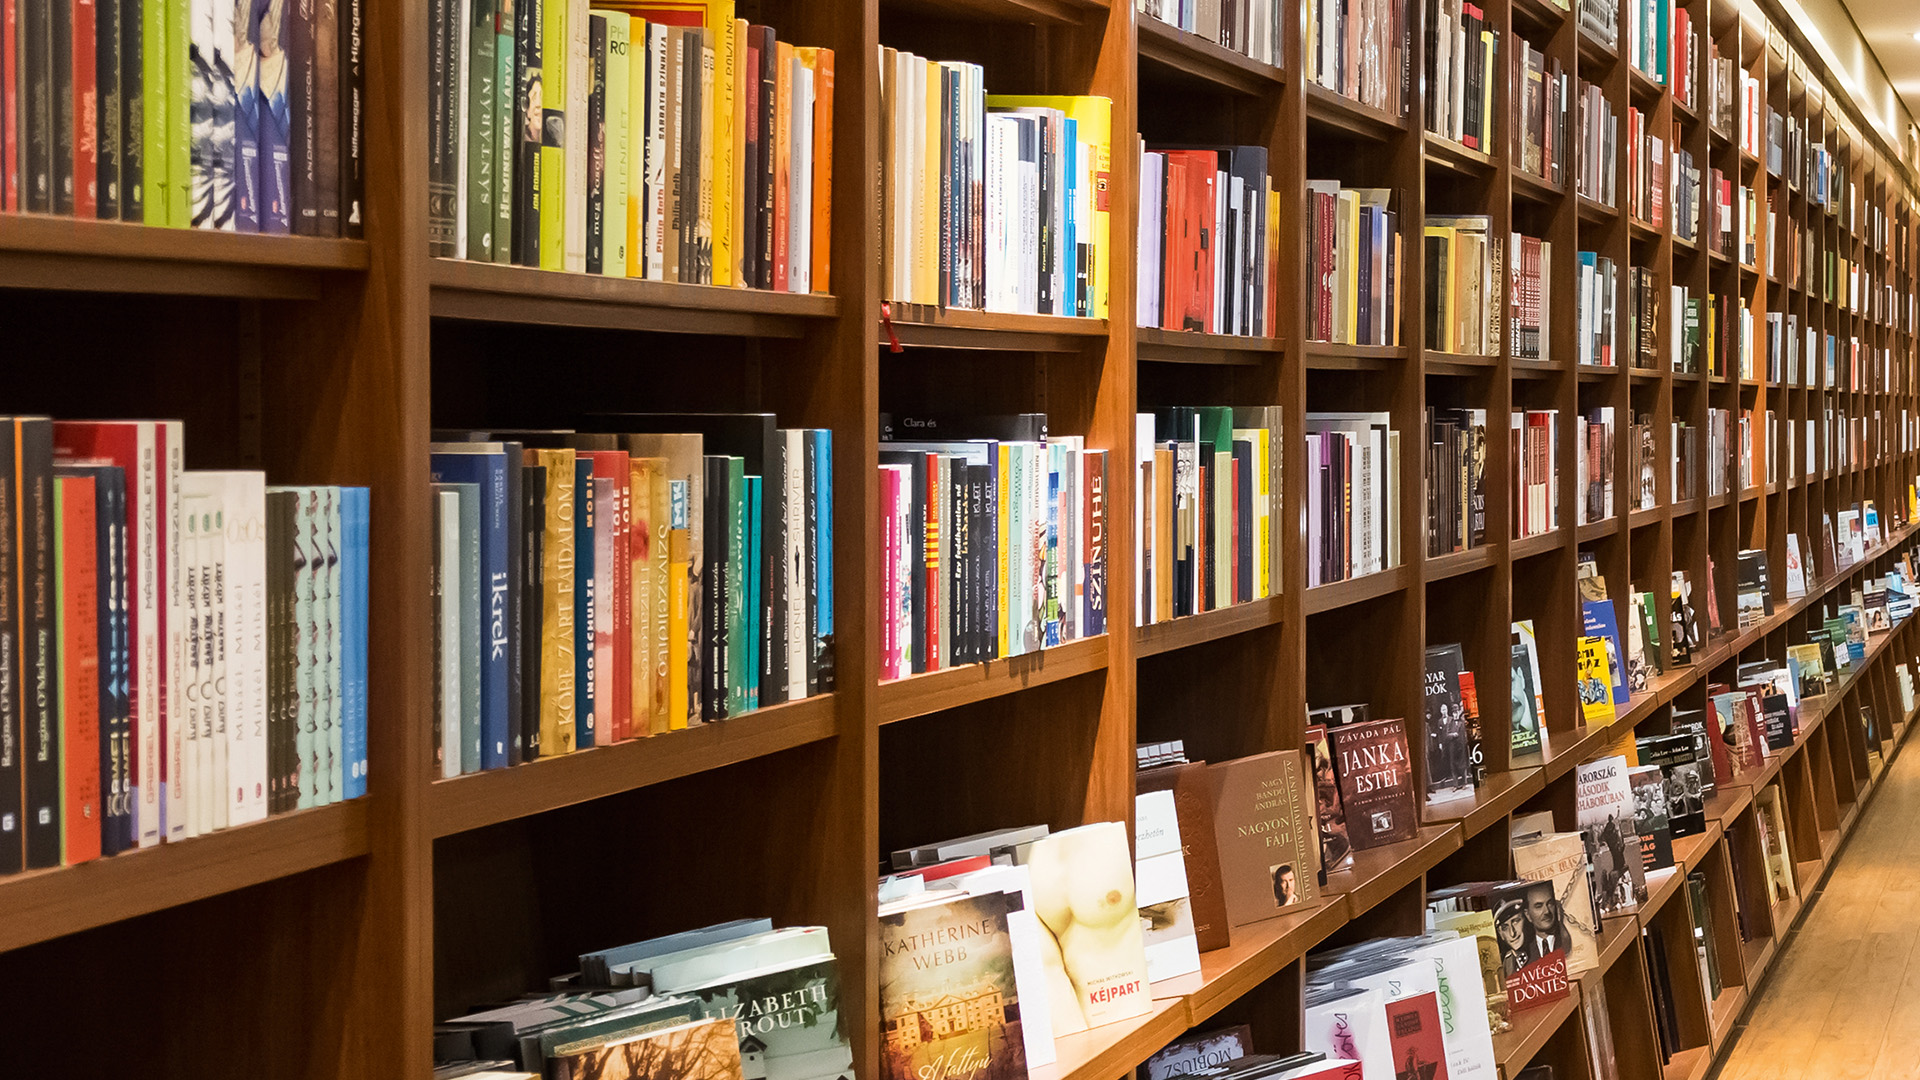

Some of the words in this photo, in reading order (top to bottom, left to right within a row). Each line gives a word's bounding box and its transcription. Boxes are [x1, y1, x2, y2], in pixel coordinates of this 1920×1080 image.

[305, 55, 313, 112] NICOLL
[501, 55, 512, 109] LÁNYA
[351, 87, 360, 159] Niffenegger
[477, 76, 492, 205] SÁNTÁRÁM
[499, 115, 511, 220] HEMINGWAY
[532, 151, 540, 191] RONSON
[672, 172, 681, 197] Roth
[532, 193, 540, 211] JON
[593, 202, 602, 236] meg
[655, 188, 664, 216] Roth
[672, 198, 680, 231] Philip
[655, 219, 664, 253] Philip
[903, 418, 925, 431] Clara
[927, 418, 937, 432] és
[792, 468, 801, 543] SHRIVER
[1012, 456, 1020, 524] Vonnegut
[142, 447, 152, 610] MÁSSÁSZÜLETÉS
[171, 446, 180, 607] MÁSSÁSZÜLETÉS
[711, 561, 719, 599] utazás
[954, 561, 962, 579] Egy
[492, 572, 508, 662] ikrek
[551, 602, 573, 657] ZÁRT
[586, 578, 594, 651] SCHULZE
[792, 596, 802, 654] LIONEL
[36, 629, 49, 708] O'Melveny
[145, 633, 154, 722] OSMONDE
[172, 632, 181, 718] OSMONDE
[586, 657, 594, 700] INGO
[1, 715, 14, 767] Regina
[37, 711, 49, 761] Regina
[1339, 729, 1380, 744] ZÁVADA
[1383, 724, 1402, 736] PÁL
[145, 726, 154, 804] GABRIEL
[172, 723, 181, 799] GABRIEL
[1342, 741, 1405, 778] JANKA
[1355, 765, 1399, 794] ESTÉI
[1237, 816, 1290, 838] NAGYON
[1265, 831, 1293, 848] FÁJL
[1293, 805, 1306, 860] HARMADIK
[1301, 862, 1312, 901] OLDALA
[884, 918, 991, 957] KATHERINE
[912, 945, 968, 971] WEBB
[1089, 980, 1141, 1005] KÉJPART
[1513, 975, 1568, 1004] DÖNTÉS
[1528, 959, 1565, 983] VÉGSŐ
